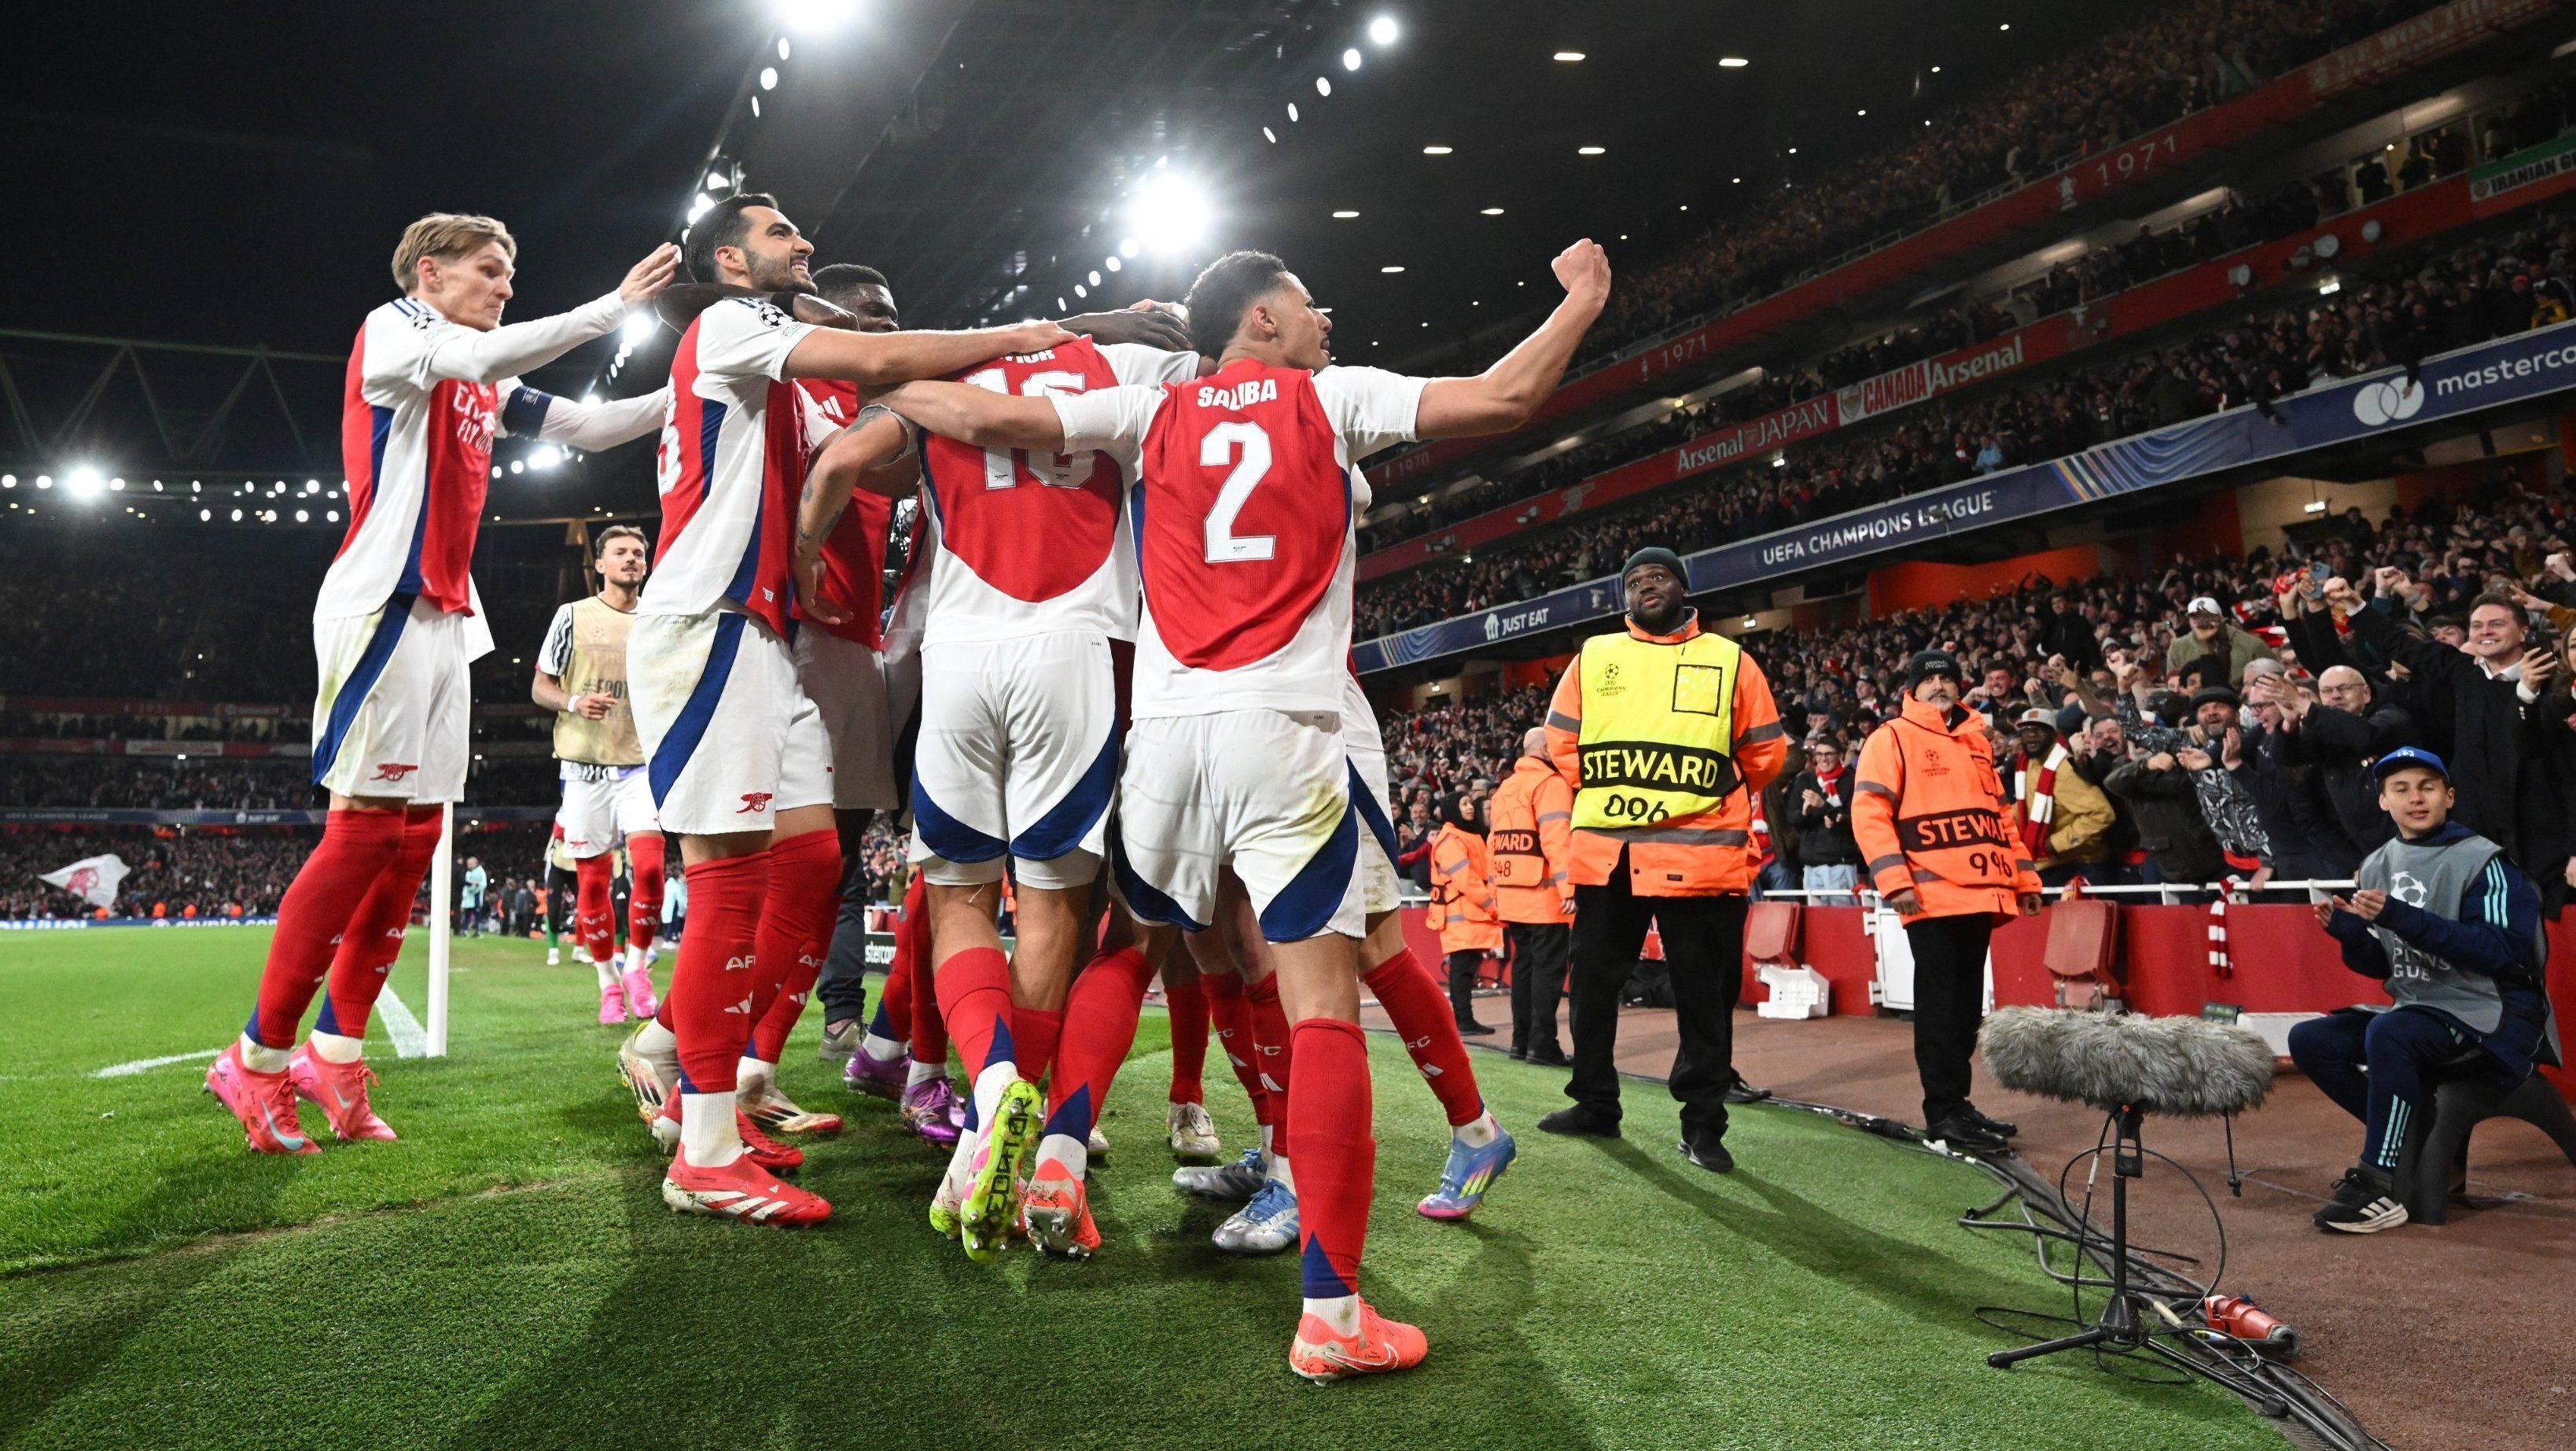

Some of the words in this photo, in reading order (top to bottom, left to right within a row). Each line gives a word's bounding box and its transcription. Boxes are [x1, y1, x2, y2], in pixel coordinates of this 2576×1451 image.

[2096, 134, 2175, 187] 1971
[2491, 160, 2556, 193] IRANIAN
[1662, 333, 1706, 368] 1971
[1931, 335, 2024, 389] Arsenal
[1198, 379, 1277, 411] SALIBA
[1863, 360, 1929, 415] CANADA
[1678, 429, 1744, 473] Arsenal
[1757, 400, 1829, 447] JAPAN
[1200, 420, 1276, 562] 2
[1763, 541, 1805, 565] UEFA
[1809, 513, 1912, 554] CHAMPIONS
[1918, 491, 1993, 527] LEAGUE
[1502, 613, 1527, 635] JUST
[1529, 607, 1549, 628] EAT
[1583, 749, 1718, 789] STEWARD
[1604, 794, 1670, 823] 096
[1494, 834, 1533, 852] WARD
[1969, 851, 2013, 878] 996
[726, 955, 755, 970] AF
[799, 954, 824, 969] AF
[2394, 963, 2431, 981] GUE
[1253, 1043, 1282, 1055] FC
[1408, 1035, 1430, 1051] FC
